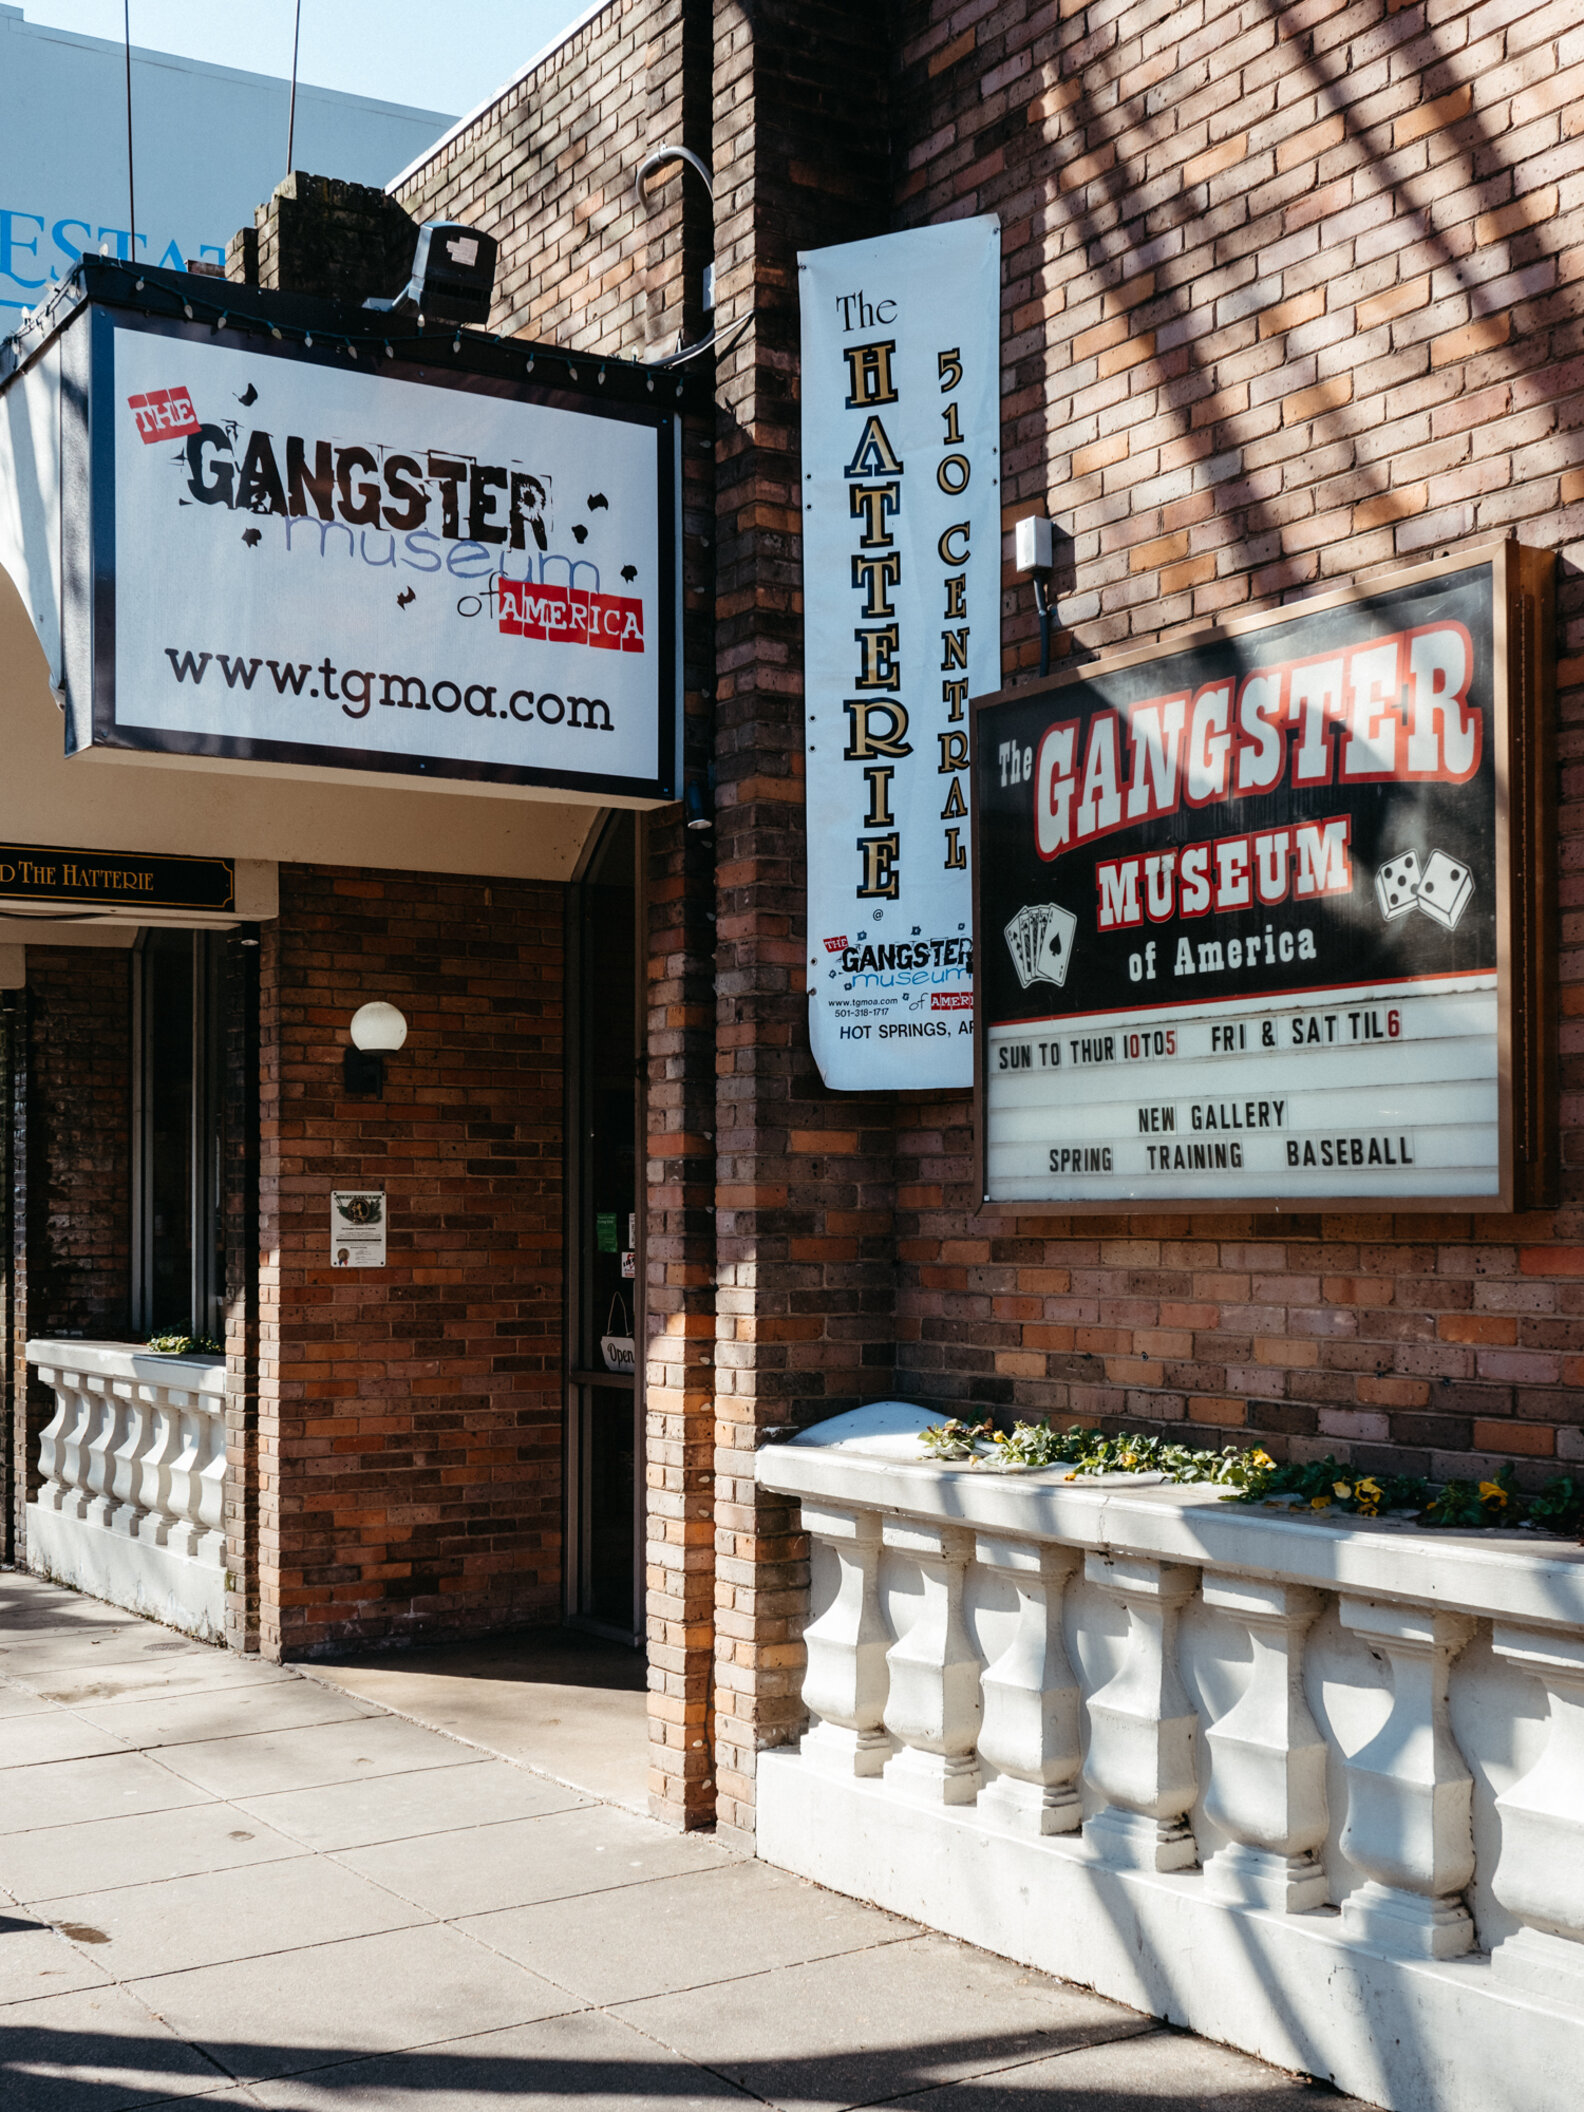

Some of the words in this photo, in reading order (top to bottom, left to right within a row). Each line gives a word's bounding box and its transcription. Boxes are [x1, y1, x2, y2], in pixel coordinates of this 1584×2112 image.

[836, 289, 898, 333] The
[133, 399, 194, 433] THE
[937, 346, 971, 496] 510
[185, 421, 552, 550] GANGSTER
[284, 515, 600, 593] museum
[457, 570, 500, 619] of
[501, 592, 643, 640] AMERICA
[843, 338, 914, 900] HATTERIE
[164, 646, 614, 731] www.tgmoa.com
[937, 520, 971, 870] CENTRAL
[999, 739, 1032, 788] The
[1033, 619, 1483, 861] GANGSTER
[1096, 814, 1353, 932] MUSEUM
[872, 908, 884, 922] @
[824, 939, 848, 950] THE
[1128, 943, 1157, 982] of
[1173, 925, 1317, 978] America
[828, 998, 898, 1008] www.tgmoa.com
[908, 992, 929, 1011] of
[852, 967, 973, 988] museum
[834, 1007, 890, 1018] 501-318-1717
[840, 1025, 872, 1040] HOT
[878, 1021, 952, 1039] SPRINGS,
[999, 1044, 1031, 1070] SUN
[1038, 1042, 1060, 1067] TO
[1070, 1036, 1114, 1064] THUR
[1211, 1023, 1246, 1051] FRI
[1262, 1020, 1275, 1047] &
[1292, 1015, 1337, 1044] SAT
[1138, 1105, 1176, 1133] NEW
[1190, 1101, 1286, 1130] GALLERY
[1049, 1146, 1113, 1172] SPRING
[1147, 1143, 1243, 1169] TRAINING
[1286, 1137, 1413, 1167] BASEBALL
[607, 1343, 634, 1368] Open
